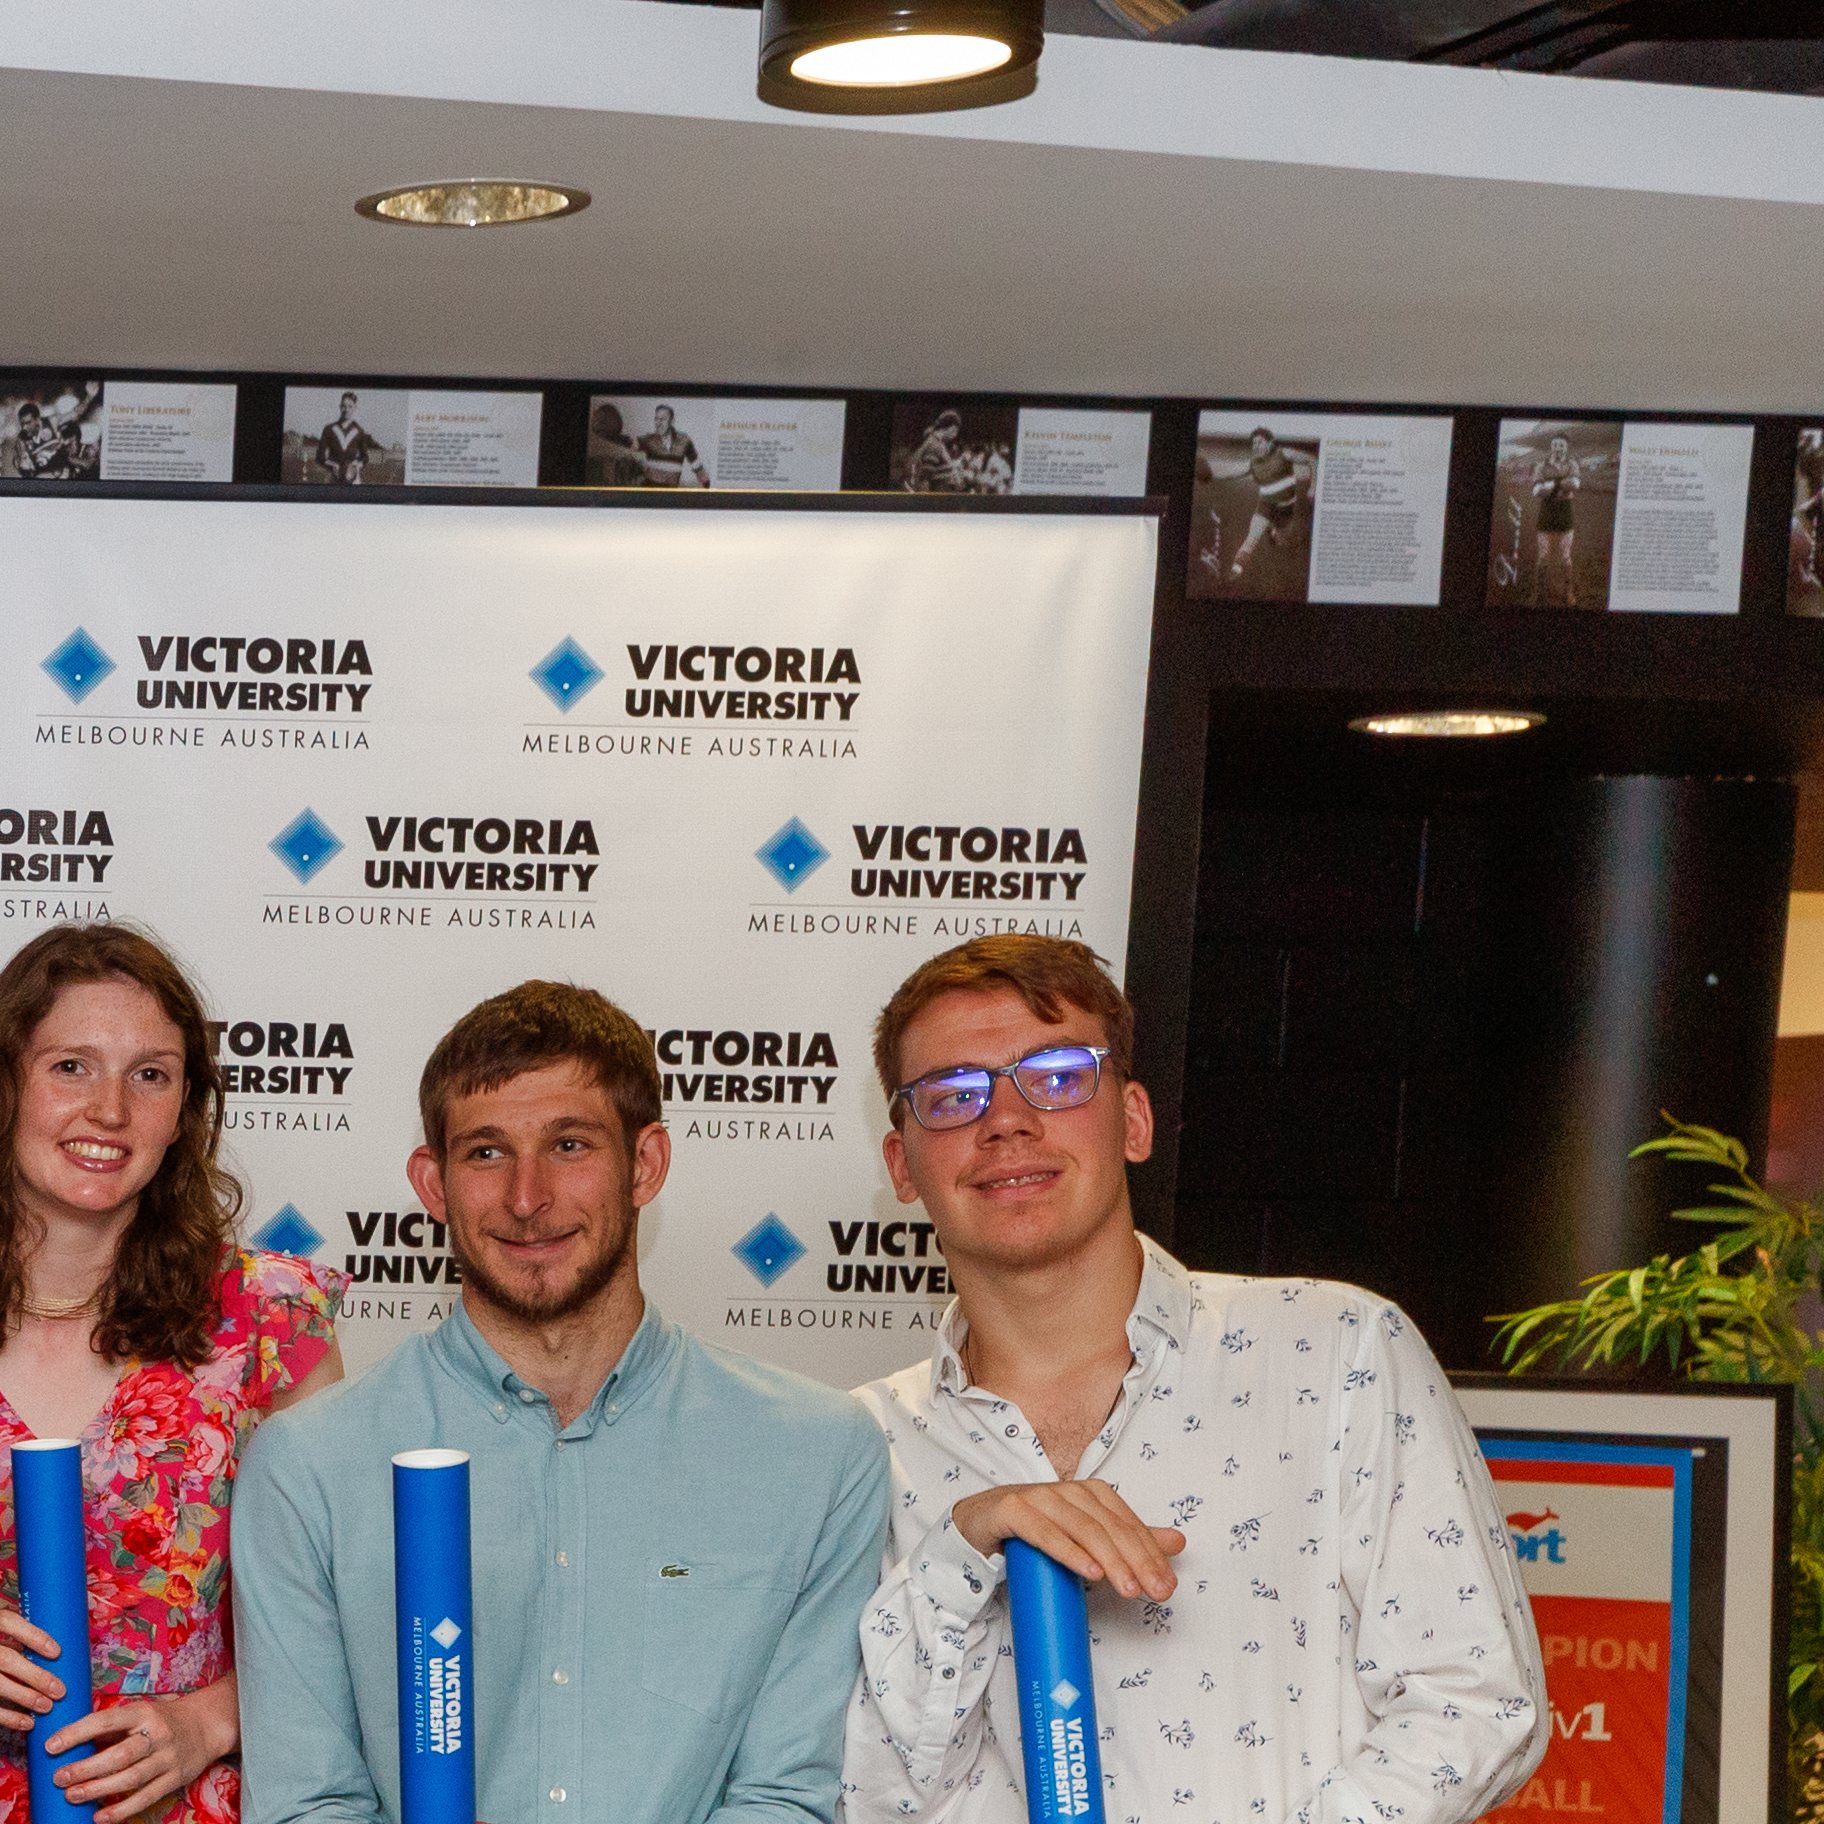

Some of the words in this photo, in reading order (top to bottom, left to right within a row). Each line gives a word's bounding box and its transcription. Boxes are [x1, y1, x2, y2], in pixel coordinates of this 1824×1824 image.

[137, 635, 373, 676] VICTORIA
[627, 644, 861, 684] VICTORIA
[137, 681, 372, 712] UNIVERSITY
[625, 689, 860, 721] UNIVERSITY
[35, 723, 205, 748] MELBOURNE
[220, 726, 371, 751] AUSTRALIA
[523, 733, 692, 756] MELBOURNE
[708, 737, 858, 758] AUSTRALIA
[365, 815, 600, 856] VICTORIA
[853, 824, 1087, 865] VICTORIA
[365, 860, 599, 893] UNIVERSITY
[851, 869, 1087, 902] UNIVERSITY
[263, 904, 432, 928] MELBOURNE
[448, 907, 597, 931] AUSTRALIA
[748, 912, 917, 936] MELBOURNE
[933, 917, 1082, 937] AUSTRALIA
[663, 1073, 837, 1104] IVERSITY
[224, 1111, 350, 1132] USTRALIA
[687, 1120, 834, 1140] AUSTRALIA
[725, 1308, 893, 1329] MELBOURNE
[413, 1616, 423, 1687] MELBOURNE
[428, 1657, 444, 1755] UNIVERSITY
[445, 1655, 461, 1754] VICTORIA
[1032, 1680, 1047, 1751] MELBOURNE
[414, 1692, 425, 1754] AUSTRALIA
[1050, 1719, 1071, 1816] UNIVERSITY
[1066, 1717, 1090, 1816] VICTORIA
[1039, 1756, 1052, 1818] AUSTRALIA
